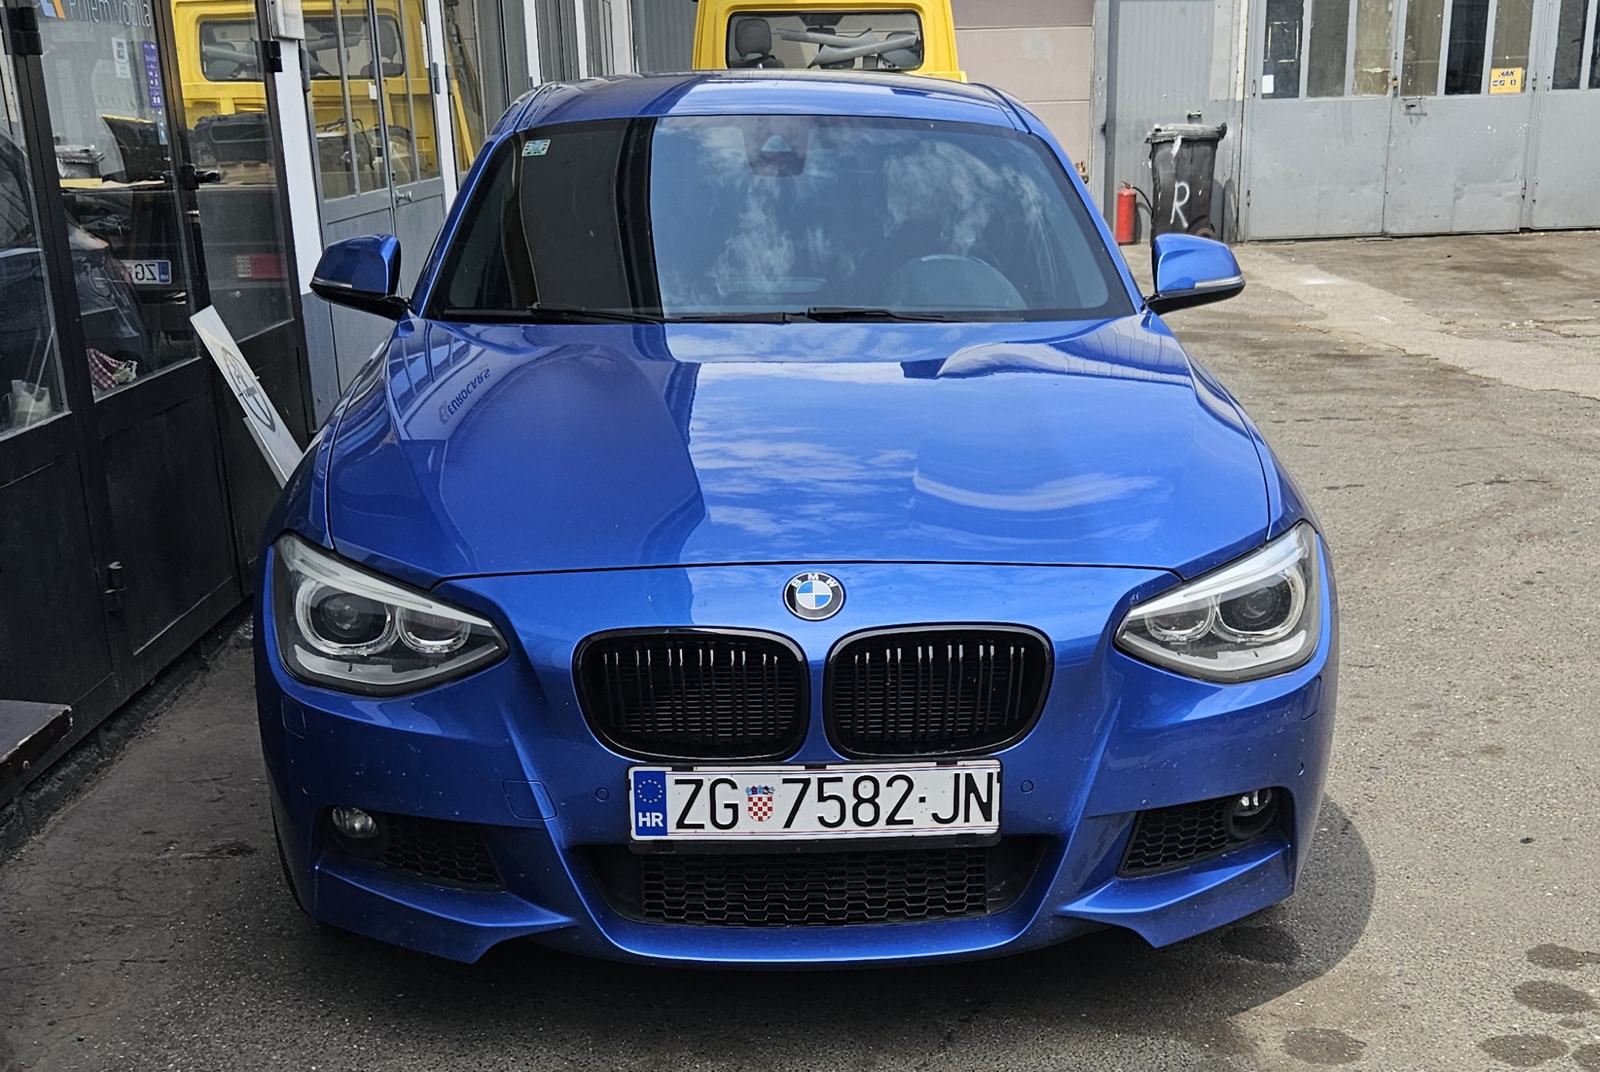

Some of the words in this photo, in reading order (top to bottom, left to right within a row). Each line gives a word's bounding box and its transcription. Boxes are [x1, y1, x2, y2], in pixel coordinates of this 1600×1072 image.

[1169, 180, 1190, 229] R
[791, 573, 838, 588] BMW
[638, 812, 664, 827] HR
[674, 778, 739, 830] ZG
